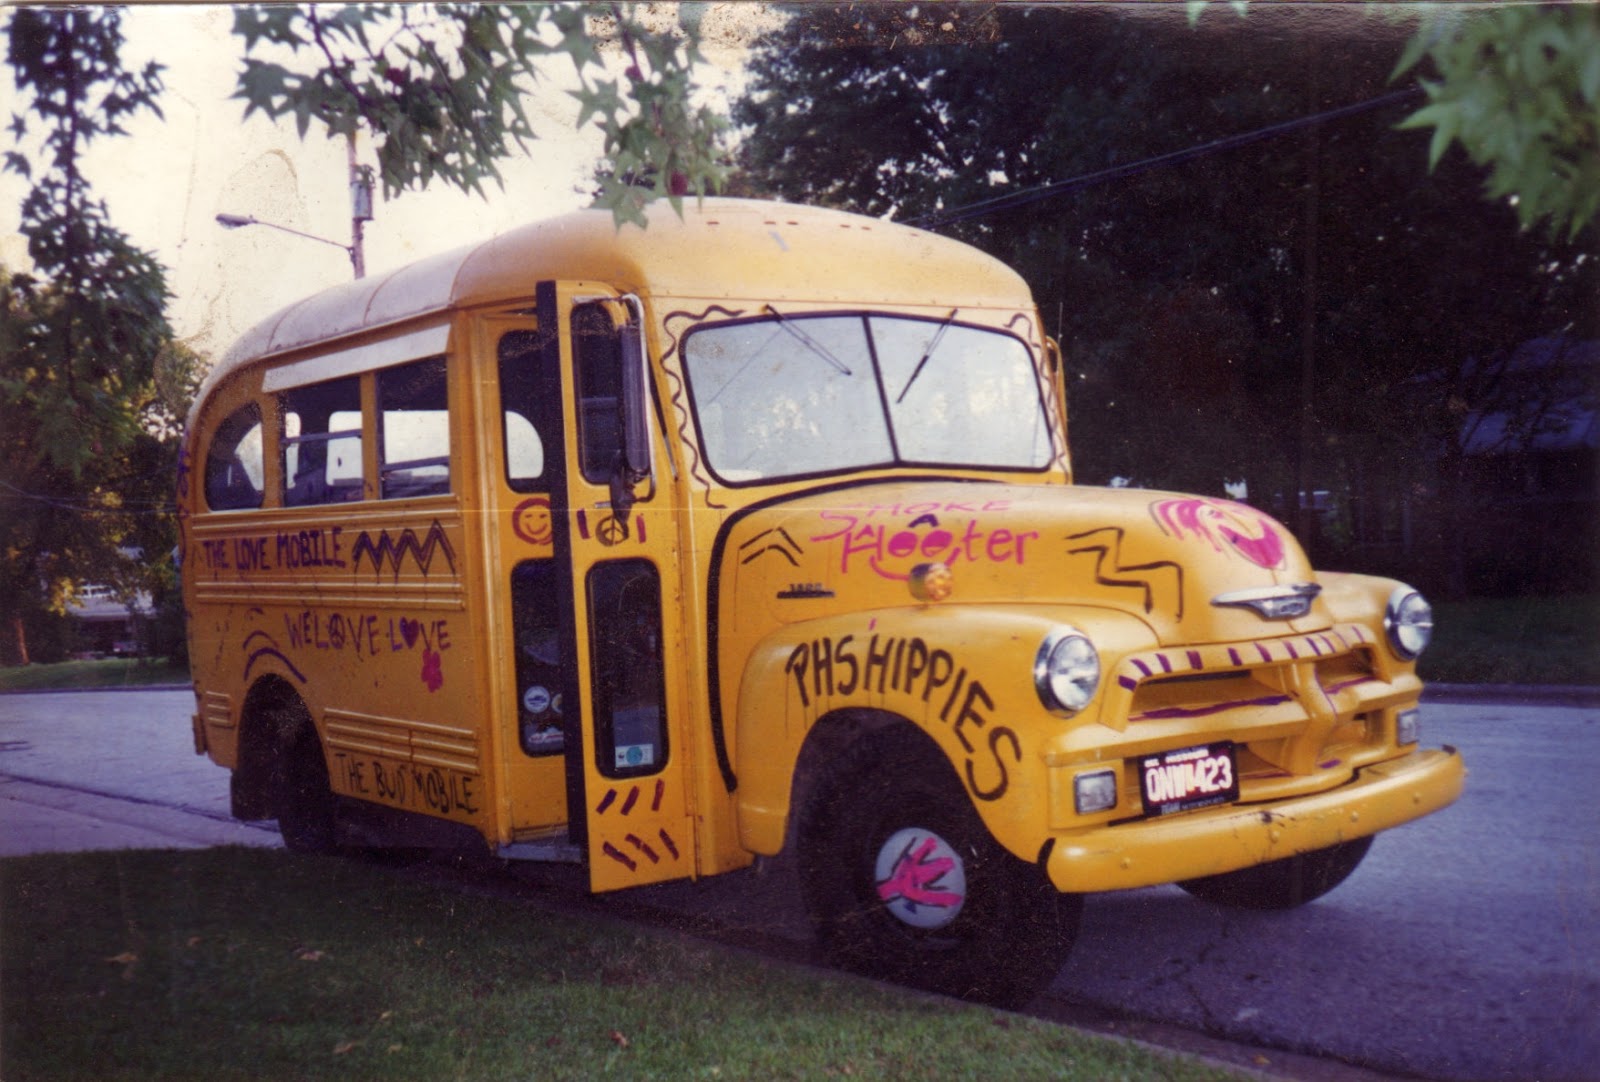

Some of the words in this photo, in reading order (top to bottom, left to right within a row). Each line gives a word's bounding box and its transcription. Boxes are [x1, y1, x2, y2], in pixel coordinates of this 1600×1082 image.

[202, 538, 230, 570] THE
[234, 536, 272, 571] LOVE
[277, 526, 346, 569] MOBILE
[785, 634, 859, 708] PHS
[863, 633, 1022, 802] HIPPIES
[335, 753, 369, 794] THE
[411, 765, 479, 815] MOBILE
